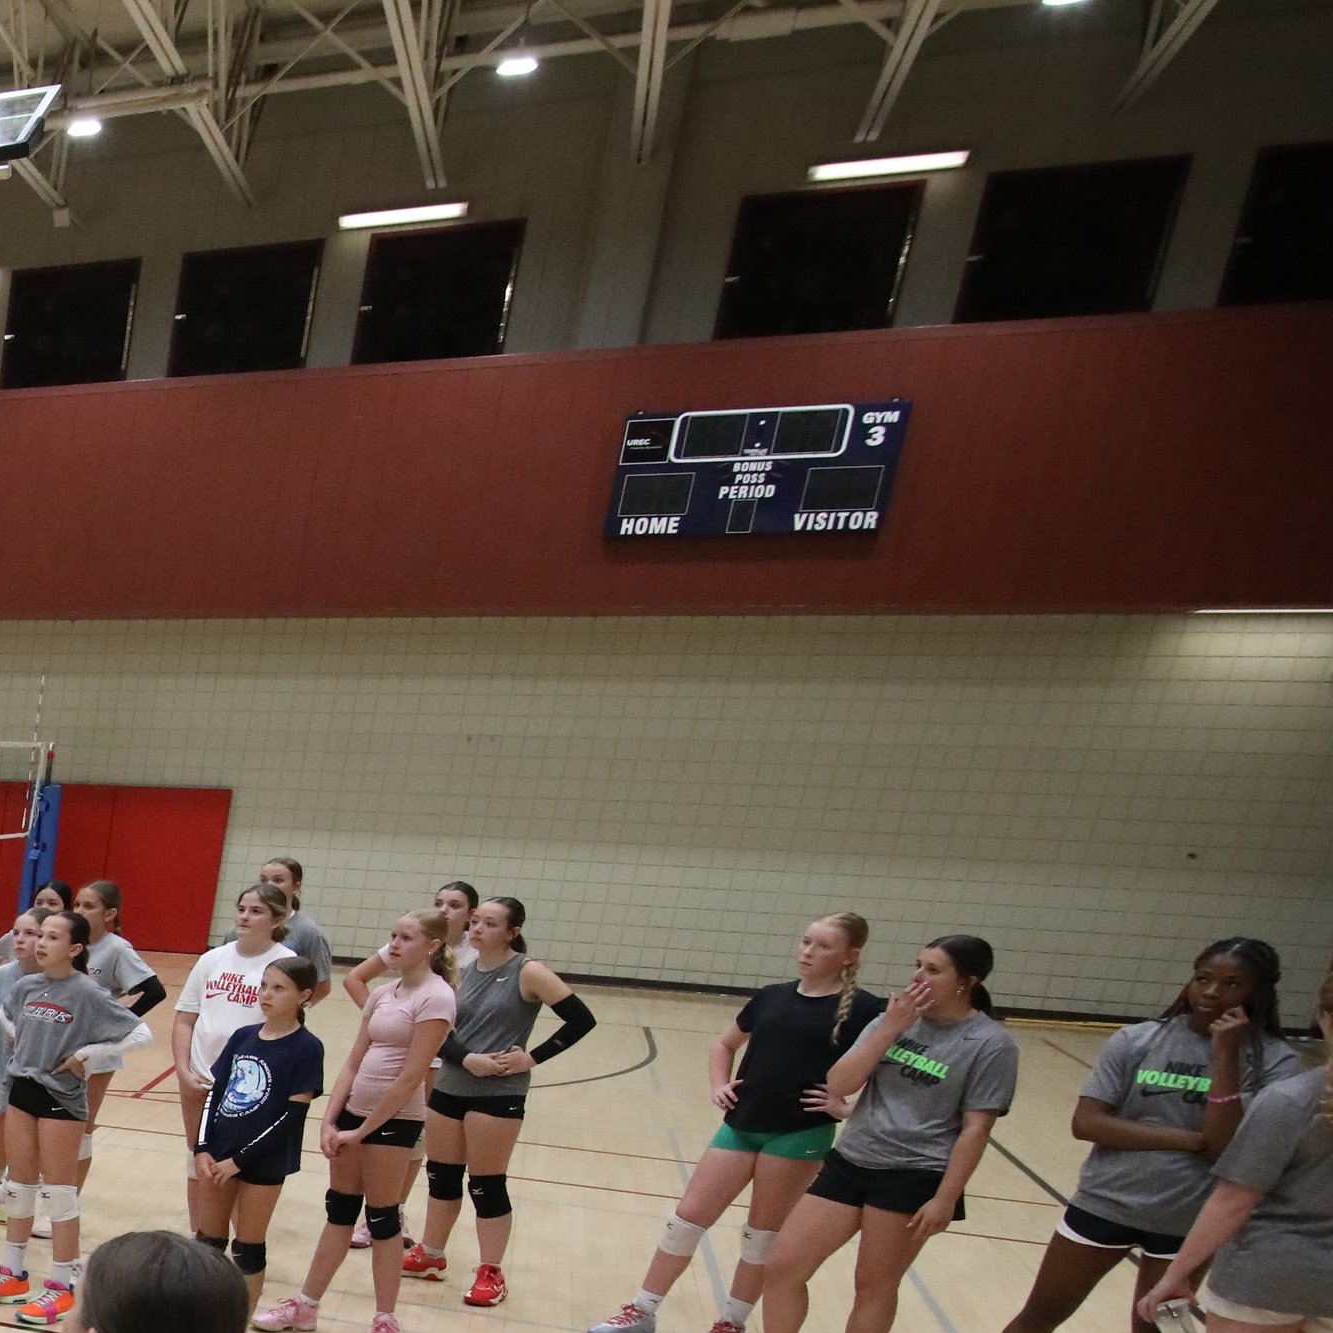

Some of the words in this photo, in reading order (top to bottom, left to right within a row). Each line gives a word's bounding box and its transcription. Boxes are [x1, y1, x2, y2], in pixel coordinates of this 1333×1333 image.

[862, 410, 900, 424] GYM
[626, 438, 651, 447] UREC
[865, 426, 886, 446] 3
[732, 461, 773, 472] BONUS
[734, 473, 766, 484] POSS
[718, 484, 776, 499] PERIOD
[619, 516, 681, 536] HOME
[793, 511, 879, 532] VISITOR
[220, 972, 245, 983] NIKE
[206, 980, 259, 996] VOLLEYBAL
[227, 992, 257, 1005] CAMP
[896, 1037, 929, 1055] NIKE
[901, 1065, 940, 1087] CAMP
[1164, 1061, 1208, 1077] NIKE
[1136, 1070, 1212, 1092] VOLLEYB
